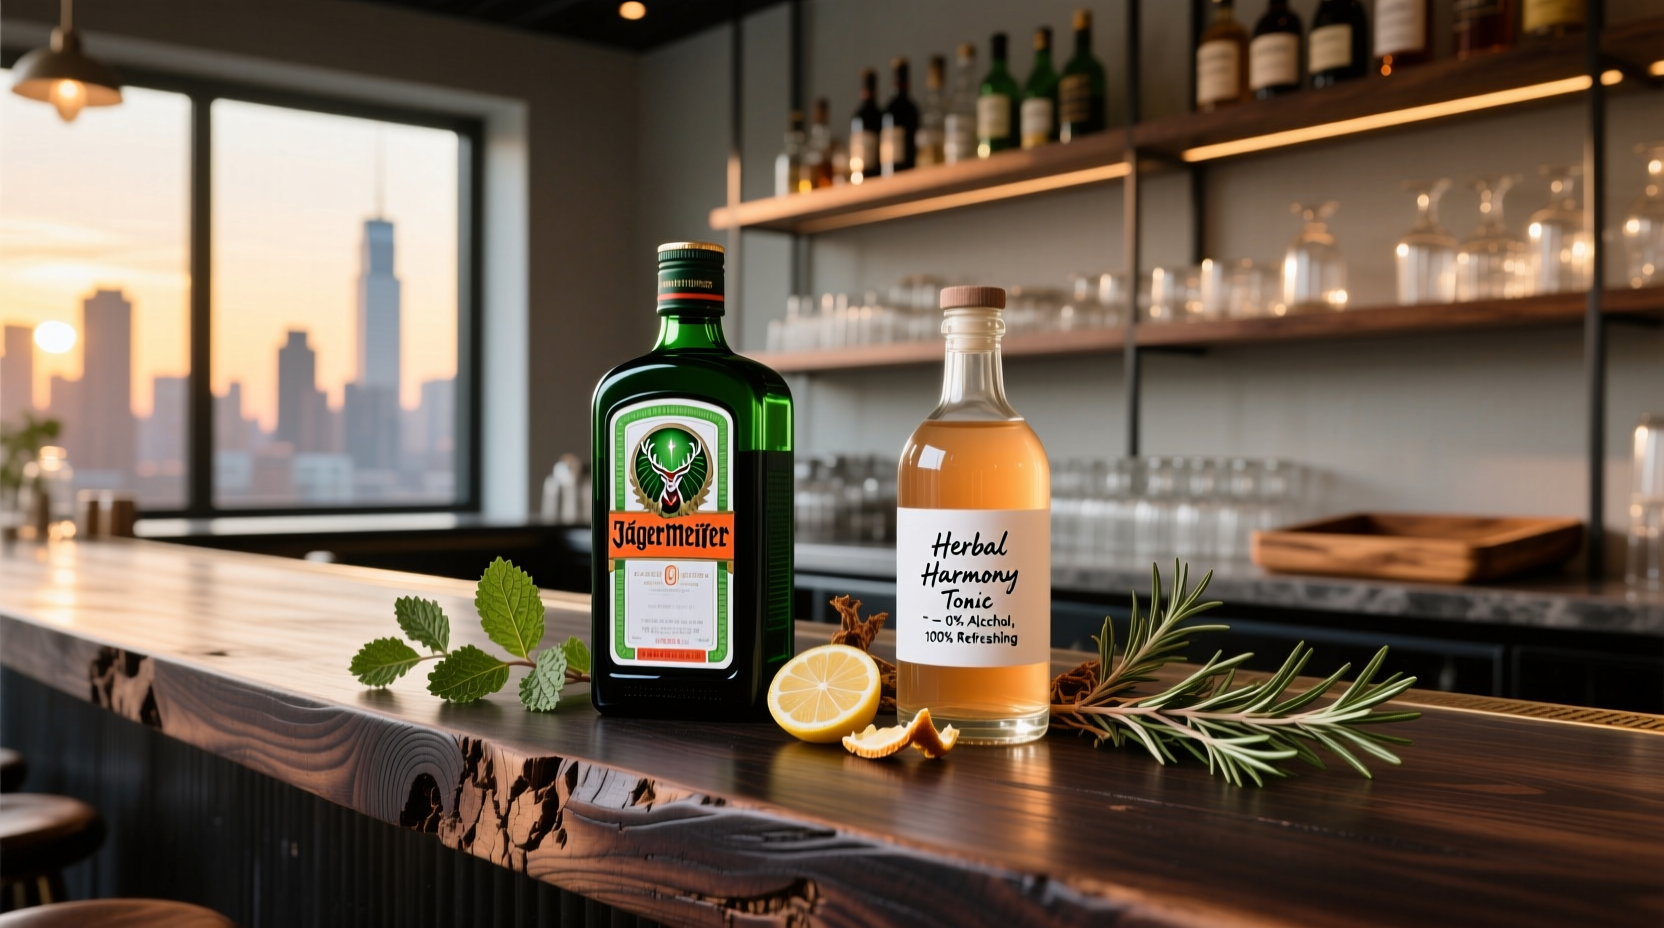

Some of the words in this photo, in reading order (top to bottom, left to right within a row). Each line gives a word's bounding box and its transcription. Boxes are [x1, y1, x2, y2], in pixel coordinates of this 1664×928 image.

[931, 530, 1009, 560] Herbal
[920, 560, 1019, 595] Harmony
[940, 588, 994, 610] Tonic
[924, 630, 954, 644] 100%
[957, 630, 1018, 647] Refreshing
